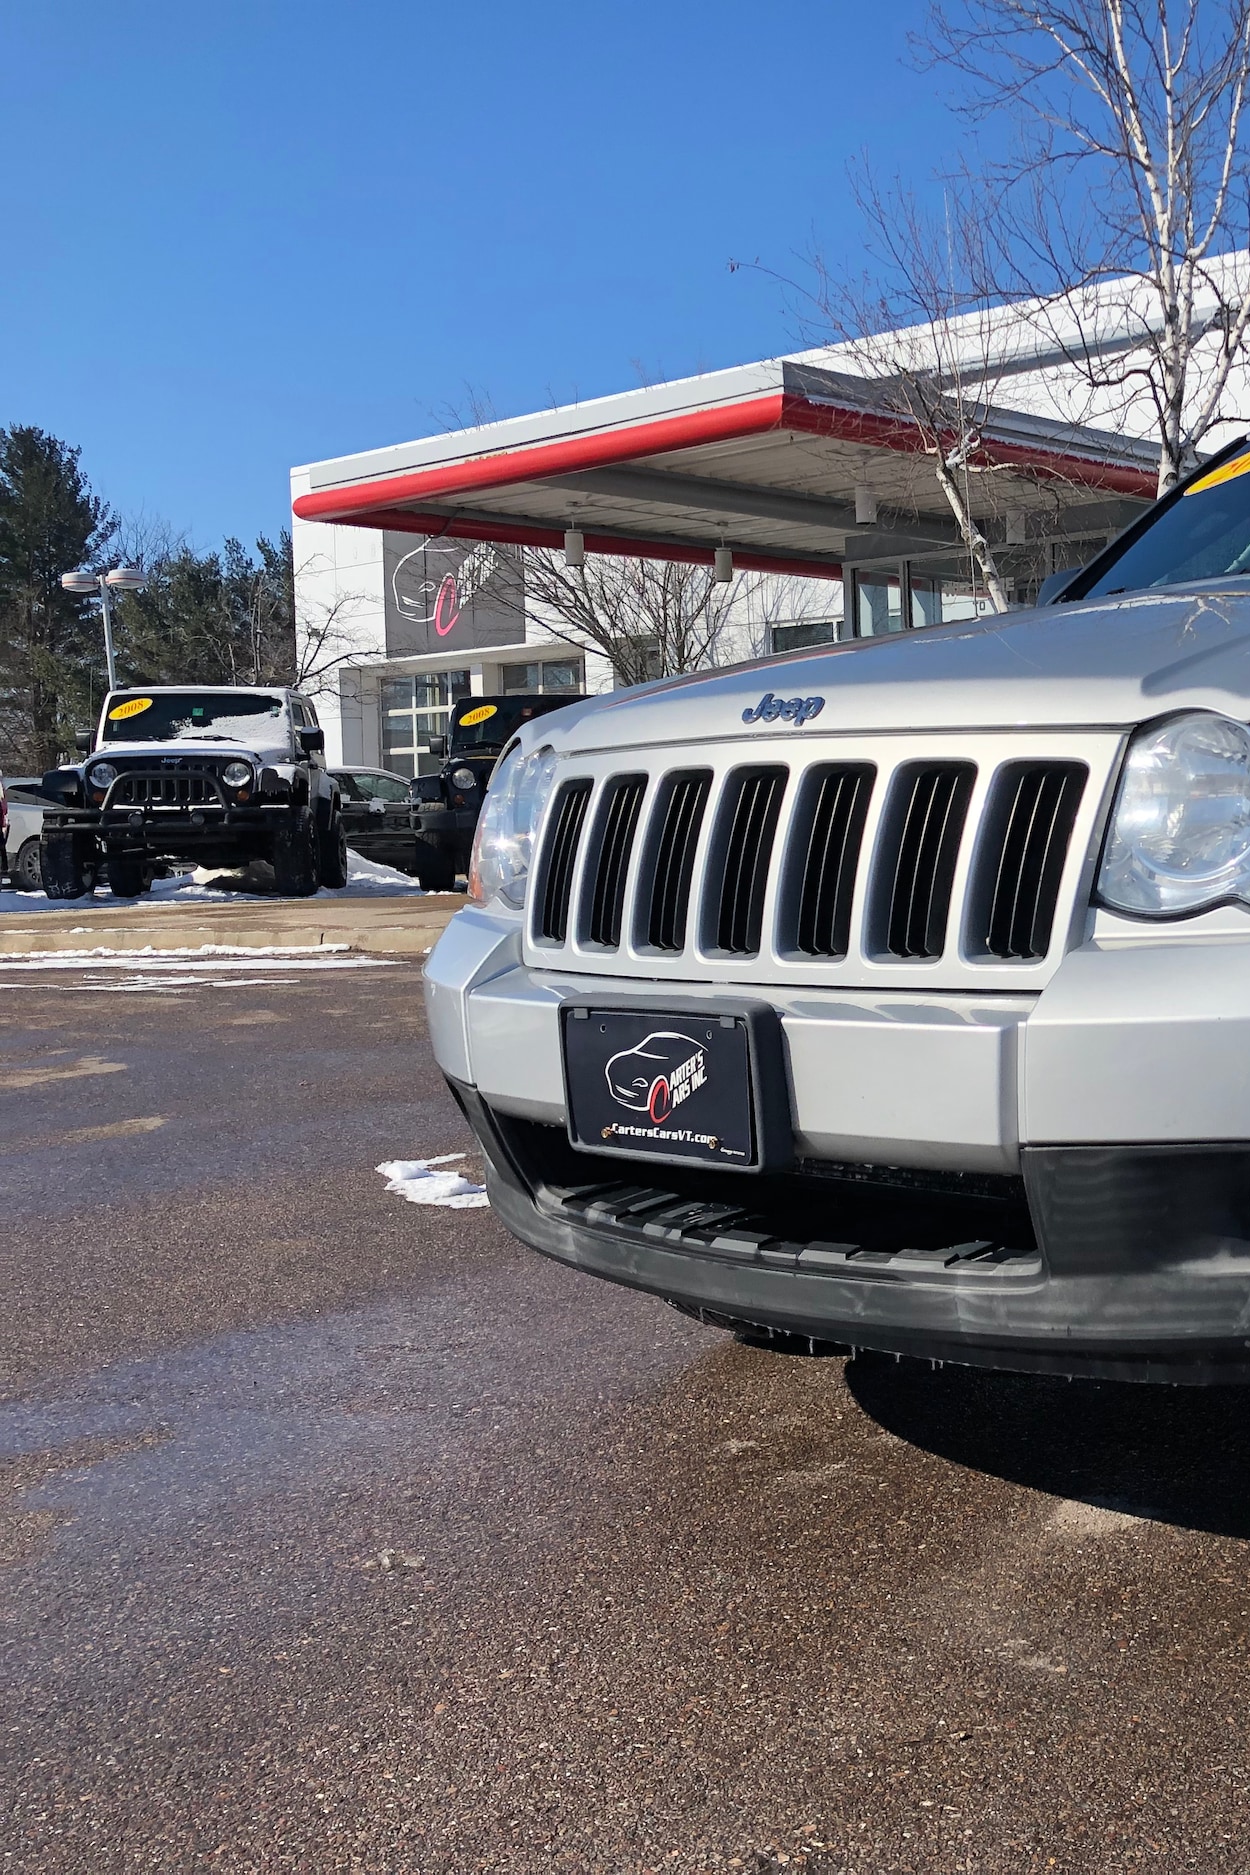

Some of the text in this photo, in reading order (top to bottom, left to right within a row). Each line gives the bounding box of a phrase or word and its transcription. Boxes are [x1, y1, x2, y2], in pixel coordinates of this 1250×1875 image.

[118, 700, 144, 717] 2008
[467, 707, 490, 725] 2008
[742, 693, 826, 727] Jeep
